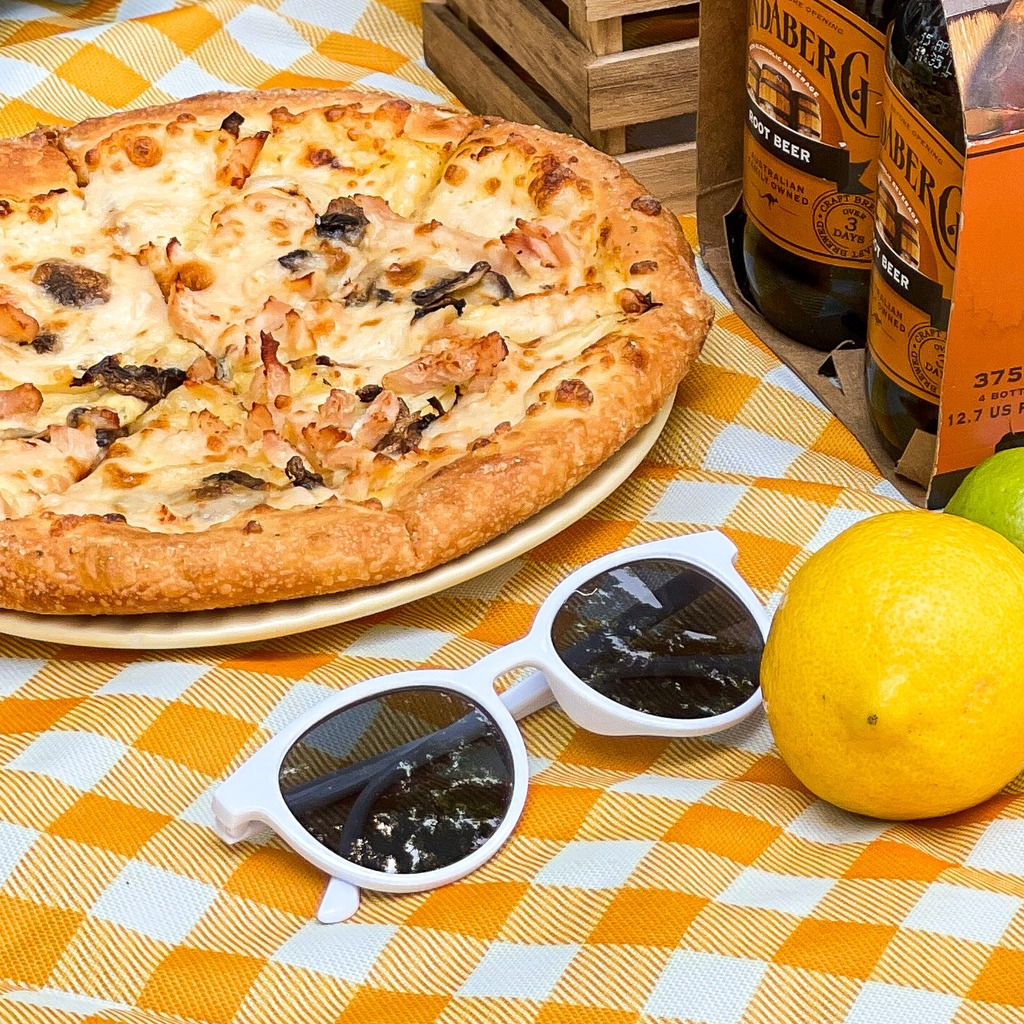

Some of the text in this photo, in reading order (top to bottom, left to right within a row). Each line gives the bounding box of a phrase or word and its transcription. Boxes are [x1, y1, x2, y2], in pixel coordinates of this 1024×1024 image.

[806, 6, 844, 35] OPENING
[782, 60, 820, 98] BEVERAGE
[748, 109, 812, 164] ROOT BEER
[770, 181, 809, 206] OWNED
[820, 194, 875, 214] CRAFT BRE
[842, 208, 867, 220] OVER
[845, 217, 857, 232] 3
[816, 220, 848, 258] BREWED
[833, 228, 865, 244] DAYS
[881, 254, 910, 291] BEER
[978, 394, 986, 402] 4
[948, 408, 983, 427] 12.7
[990, 404, 1012, 419] US
